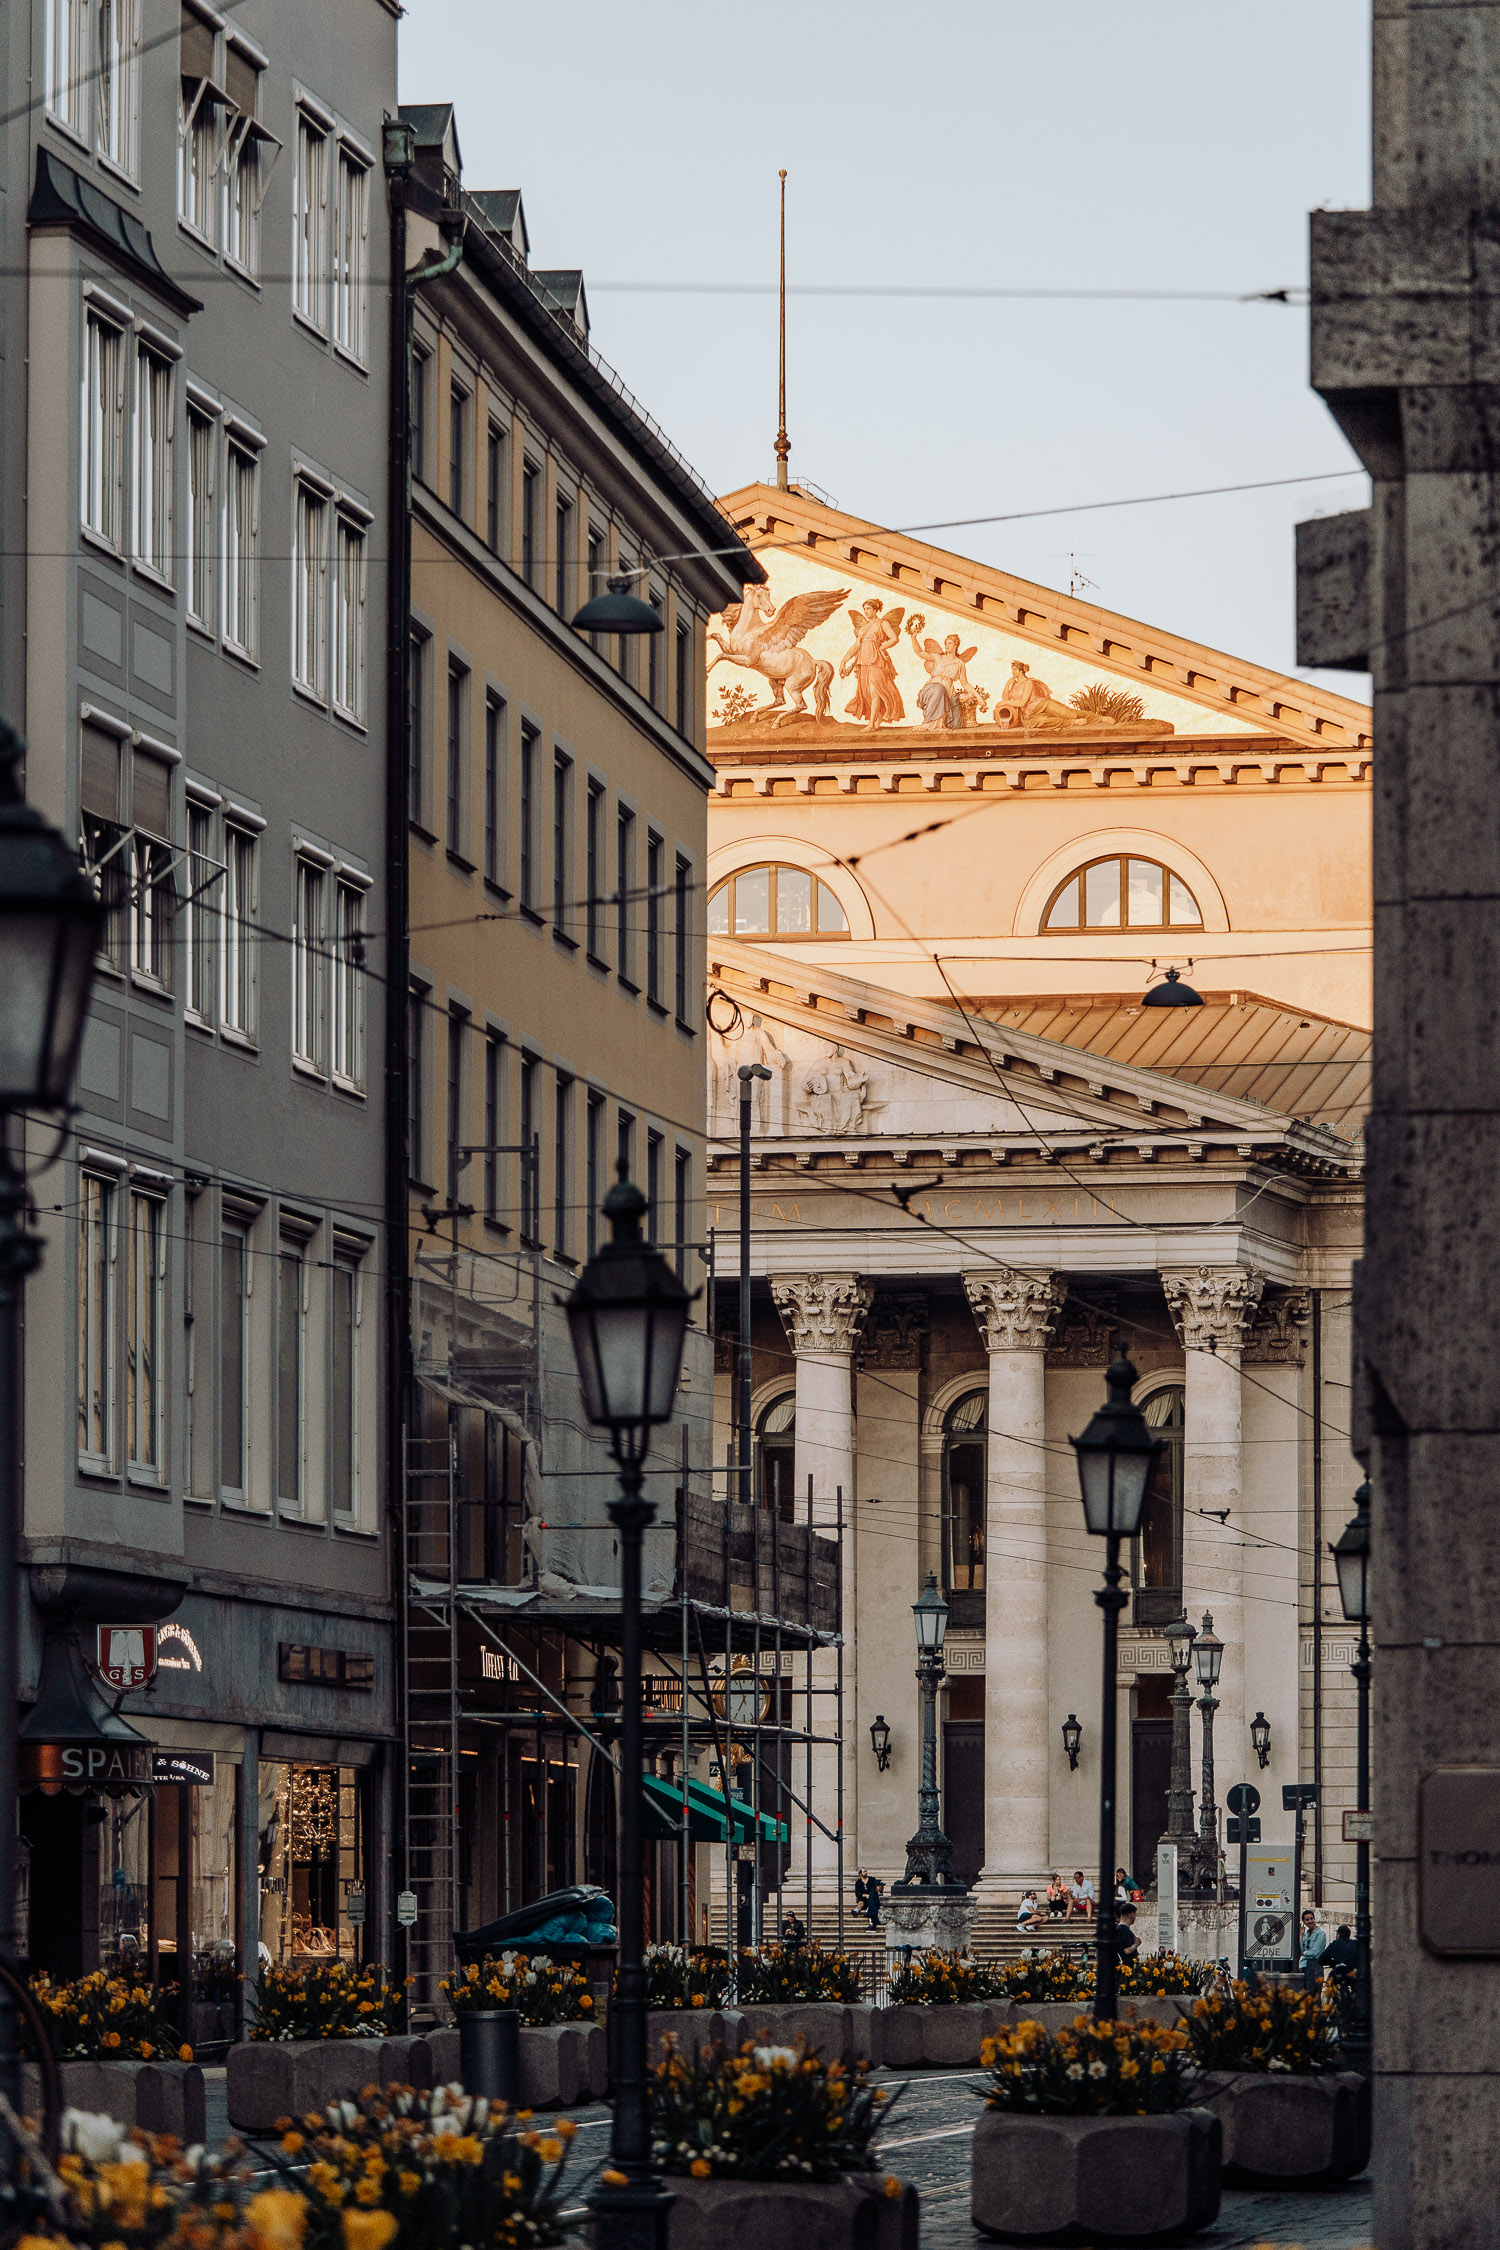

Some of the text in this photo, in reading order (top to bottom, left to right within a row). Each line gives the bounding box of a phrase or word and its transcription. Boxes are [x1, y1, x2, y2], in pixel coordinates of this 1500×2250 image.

[109, 1669, 144, 1680] G S
[171, 1760, 210, 1781] SÖHNE
[1257, 1948, 1281, 1956] ZONE
